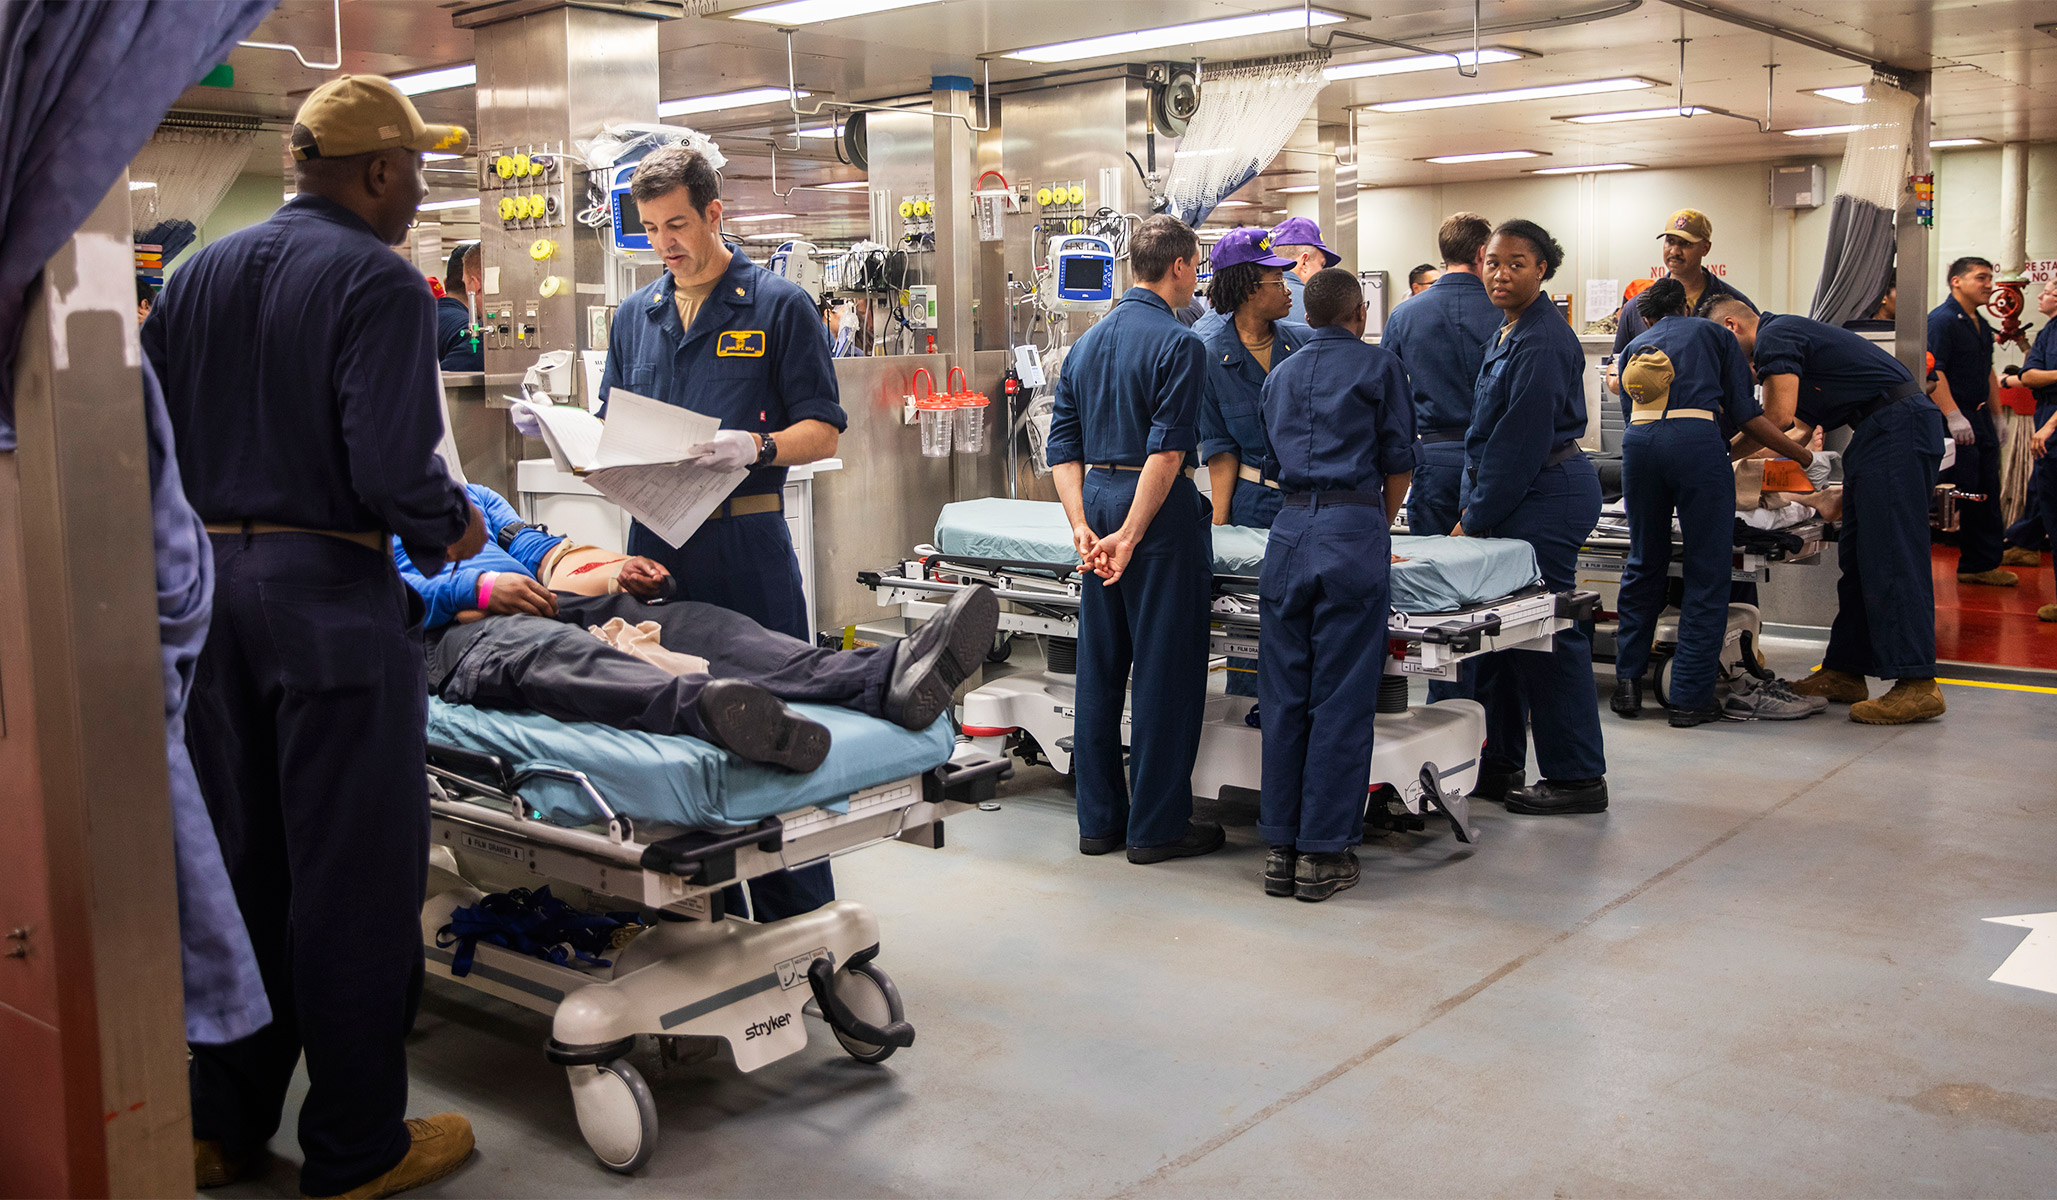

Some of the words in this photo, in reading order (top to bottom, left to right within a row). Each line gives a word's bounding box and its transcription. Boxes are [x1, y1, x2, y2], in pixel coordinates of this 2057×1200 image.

[1650, 266, 1666, 278] NO
[2032, 272, 2049, 282] NO
[474, 839, 487, 849] FILM
[488, 843, 512, 856] DRAWER
[745, 1012, 791, 1041] stryker
